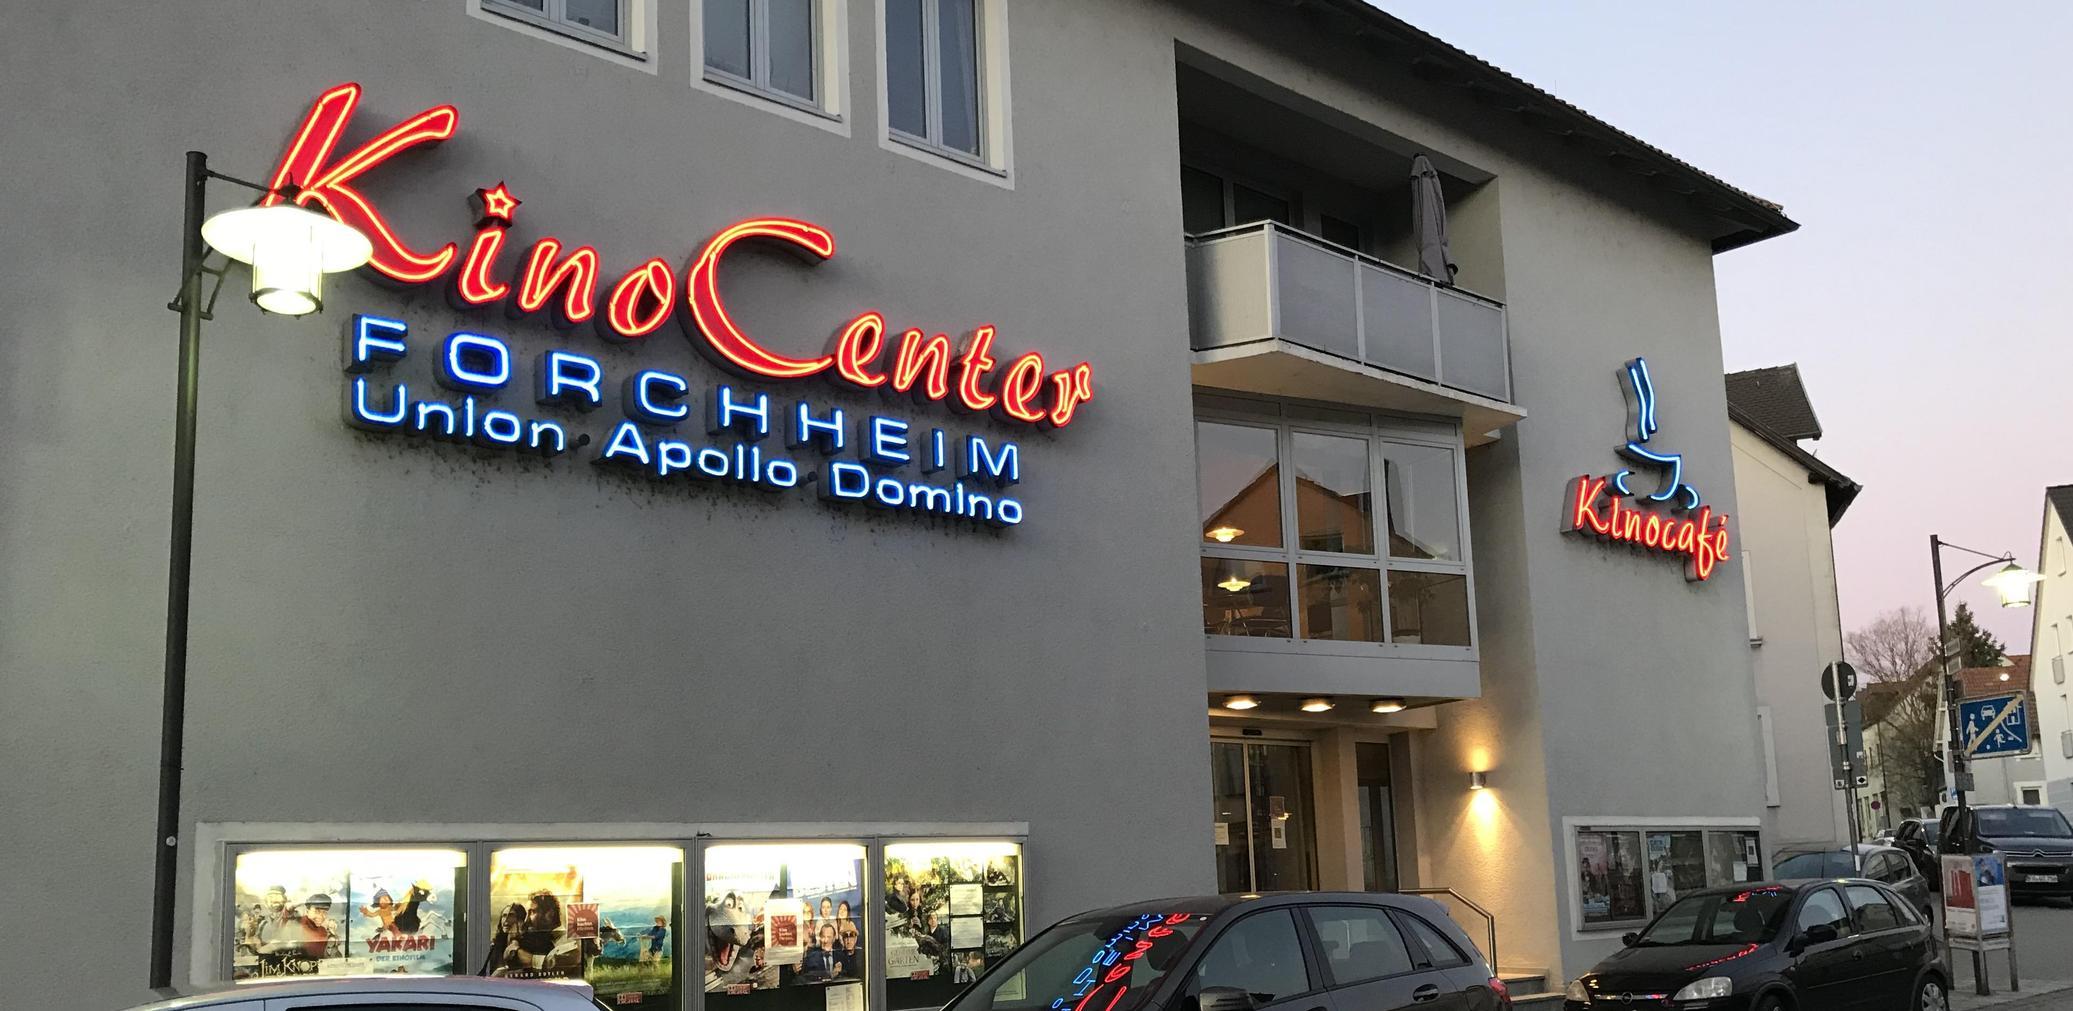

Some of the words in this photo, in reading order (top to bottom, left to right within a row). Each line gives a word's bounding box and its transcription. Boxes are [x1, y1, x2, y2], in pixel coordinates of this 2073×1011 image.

[354, 314, 1020, 484] FORCHHEIM
[354, 377, 567, 453] Union
[604, 420, 798, 488] Apollo
[830, 461, 1024, 526] Domino
[1574, 475, 1730, 580] Kinocafé
[277, 956, 319, 977] KNOP
[366, 935, 436, 953] YAKARI
